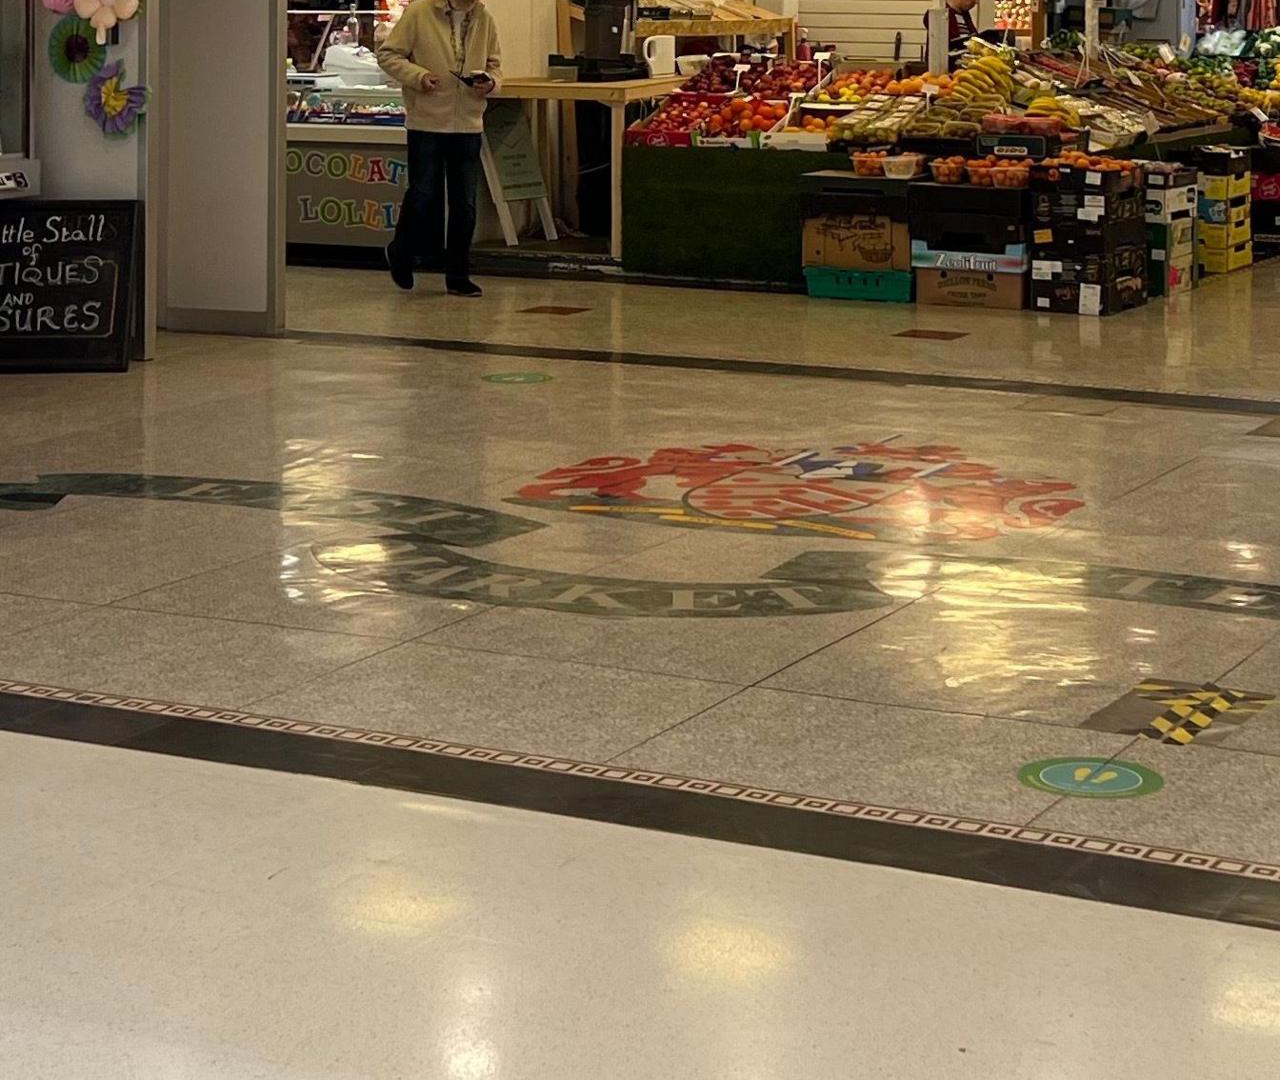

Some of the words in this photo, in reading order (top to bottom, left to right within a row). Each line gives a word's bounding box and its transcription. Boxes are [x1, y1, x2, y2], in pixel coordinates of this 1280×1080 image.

[286, 148, 408, 188] OCOLAT
[43, 214, 106, 245] Stall
[22, 243, 42, 266] of
[3, 292, 34, 308] AND
